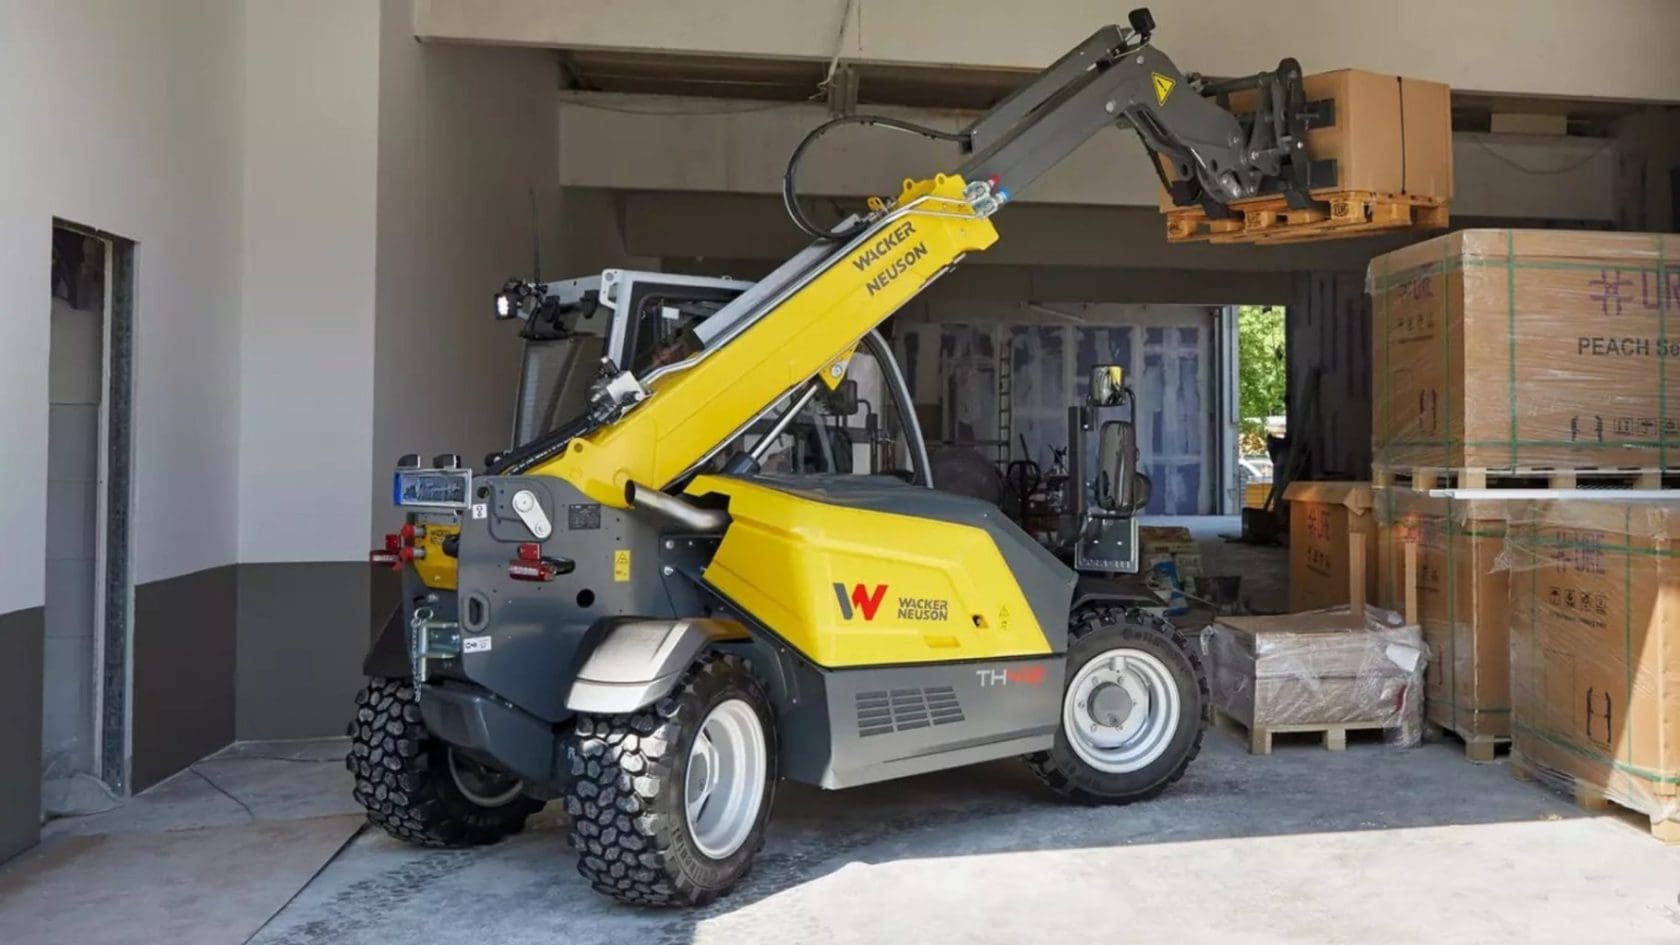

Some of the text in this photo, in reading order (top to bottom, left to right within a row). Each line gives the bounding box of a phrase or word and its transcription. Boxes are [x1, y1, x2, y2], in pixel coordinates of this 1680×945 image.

[852, 221, 916, 272] WACKER
[866, 241, 928, 296] NEUSON
[1577, 337, 1649, 355] PEACH
[898, 597, 948, 610] WACKER
[897, 608, 948, 621] NEUSON
